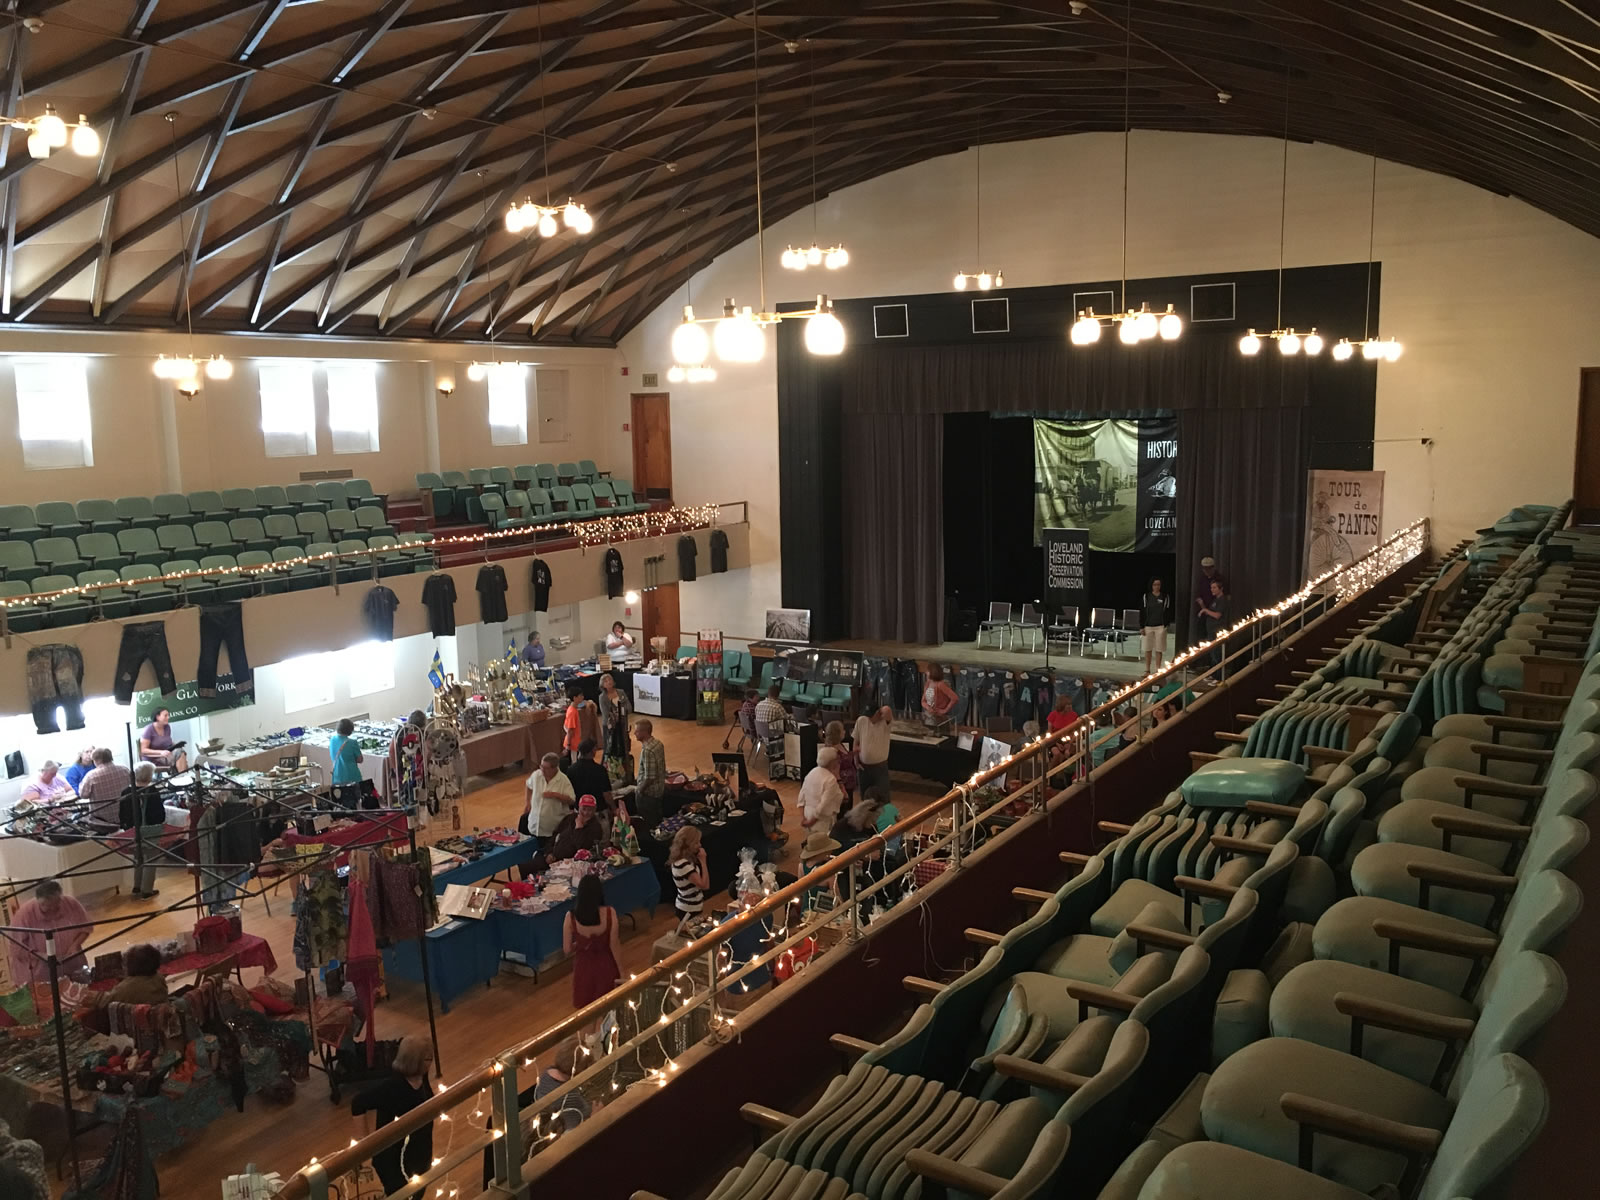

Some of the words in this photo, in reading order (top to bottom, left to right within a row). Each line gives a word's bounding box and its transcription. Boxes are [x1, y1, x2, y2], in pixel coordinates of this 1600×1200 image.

[1329, 481, 1362, 497] TOUR
[1354, 501, 1368, 510] de
[1338, 513, 1378, 536] PANTS
[1049, 540, 1084, 553] LOVELAND
[1049, 551, 1084, 565] HISTORIC
[1049, 563, 1084, 577] PRESERVATION
[1049, 575, 1084, 589] COMMISSION
[185, 706, 198, 715] CO
